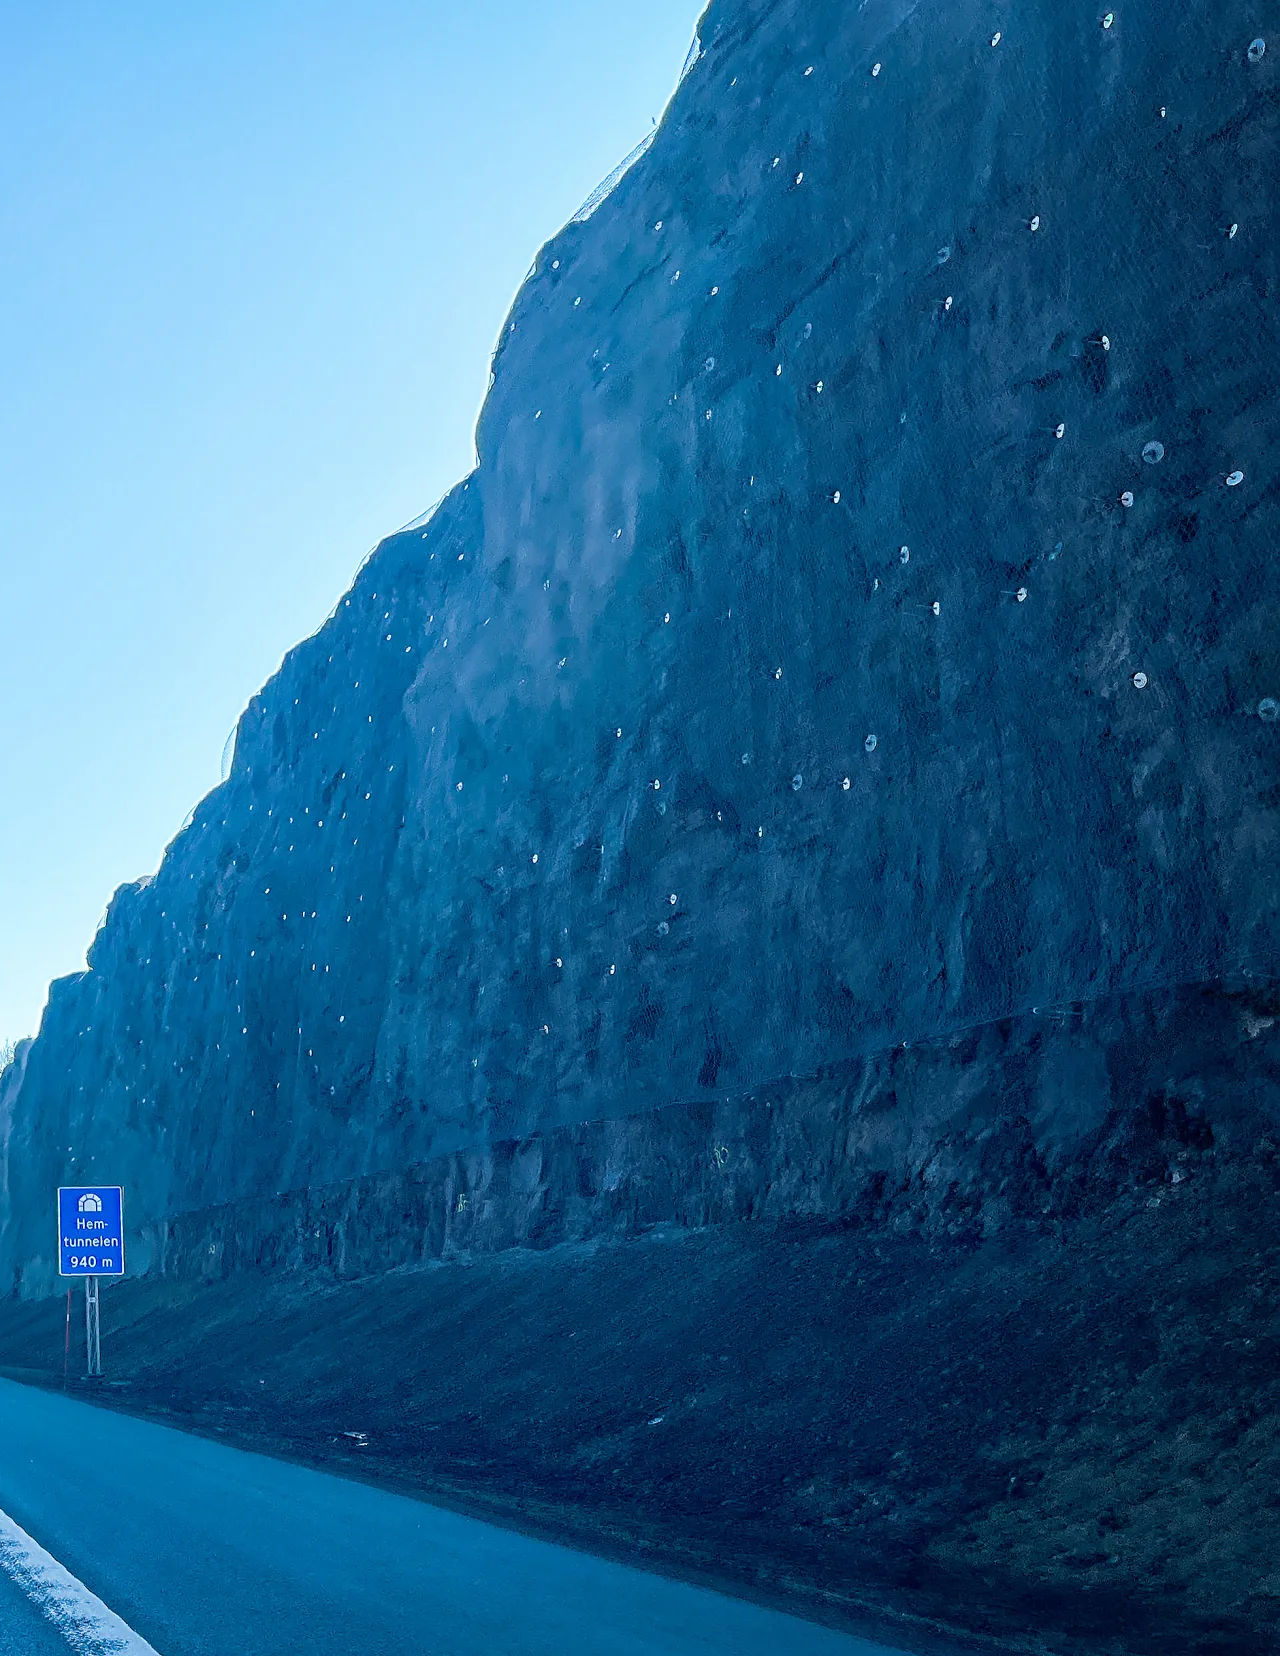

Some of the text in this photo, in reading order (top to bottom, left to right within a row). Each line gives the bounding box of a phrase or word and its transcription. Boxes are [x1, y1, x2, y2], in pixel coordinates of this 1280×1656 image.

[76, 1217, 109, 1230] Hem-
[63, 1235, 119, 1247] tunnelen
[70, 1256, 113, 1268] 940 m
